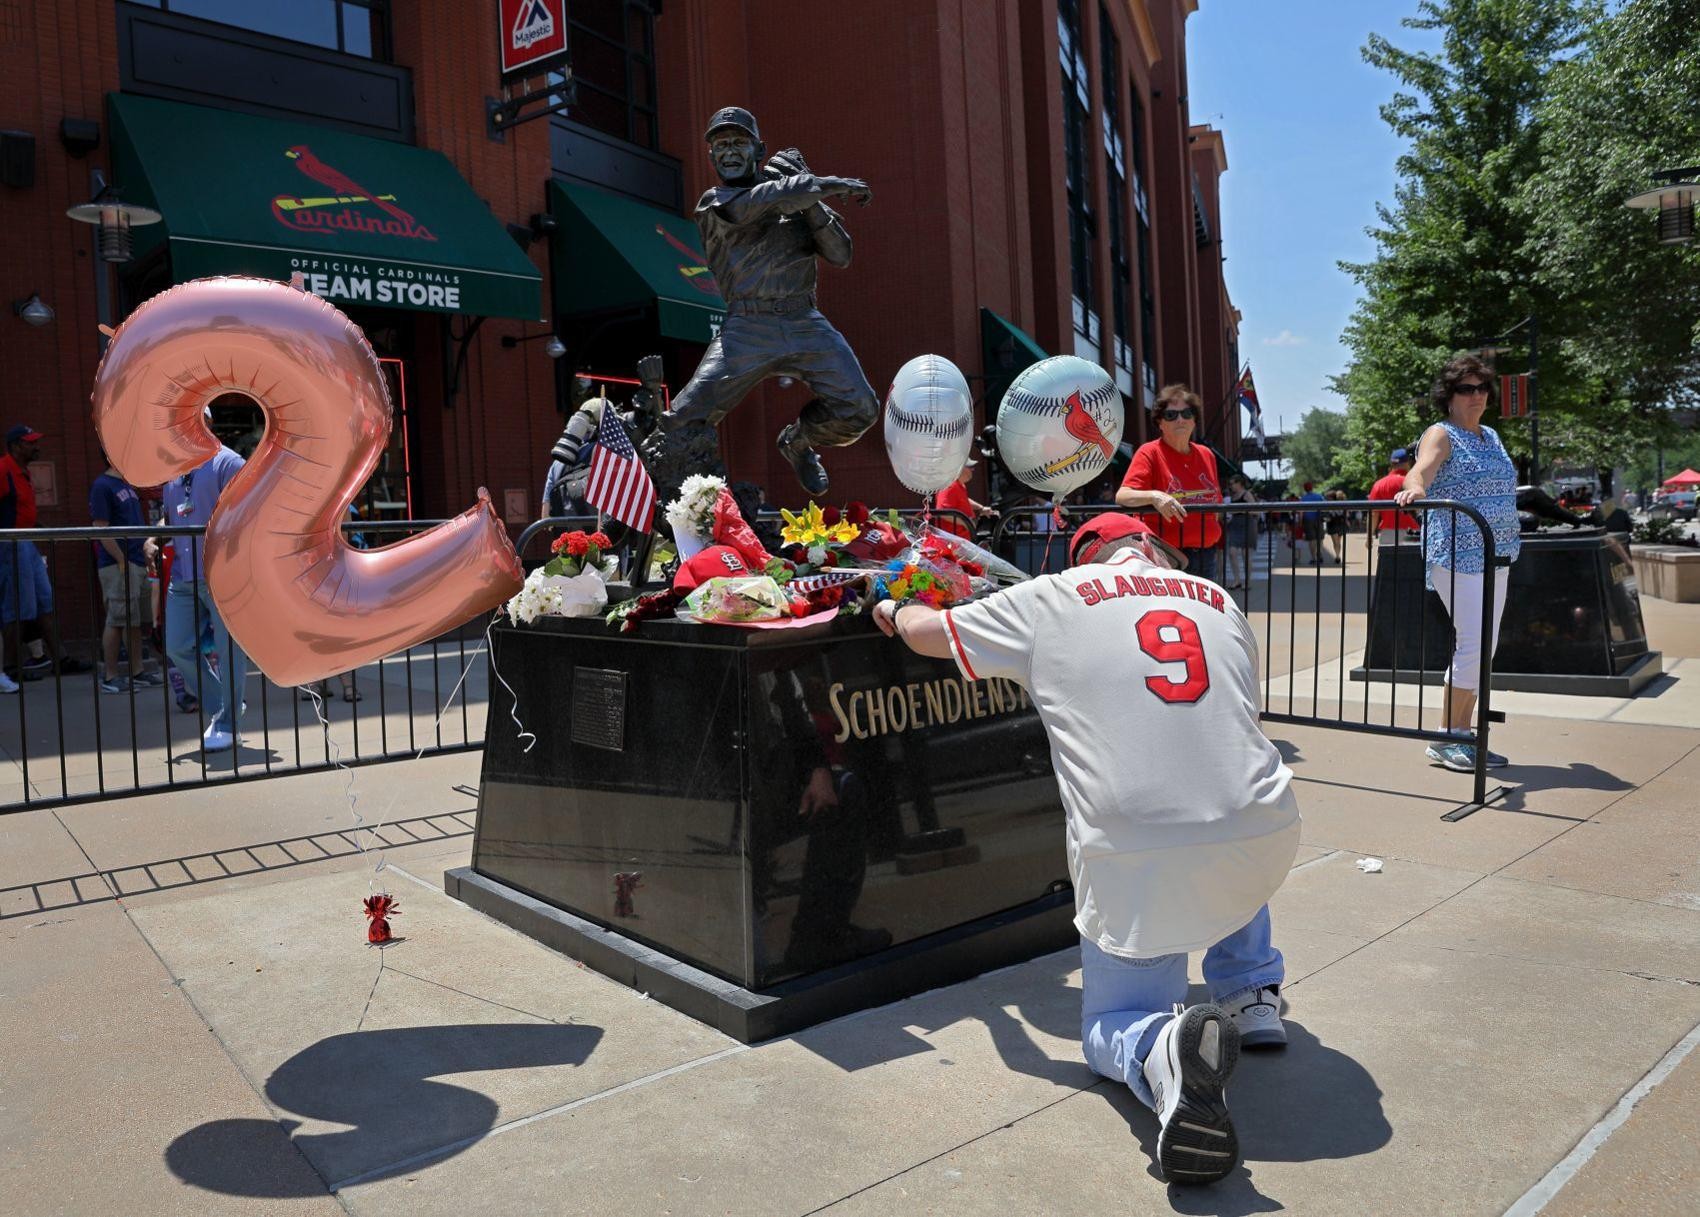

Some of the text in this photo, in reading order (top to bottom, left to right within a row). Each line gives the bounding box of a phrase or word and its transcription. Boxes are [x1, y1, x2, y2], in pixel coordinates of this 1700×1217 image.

[515, 24, 551, 44] Majestic
[271, 194, 438, 242] Cardinals
[291, 258, 460, 284] OFFICIAL CARDINALS
[376, 279, 460, 309] STORE
[1076, 575, 1225, 614] SLAUGHTER
[1135, 609, 1210, 703] 9
